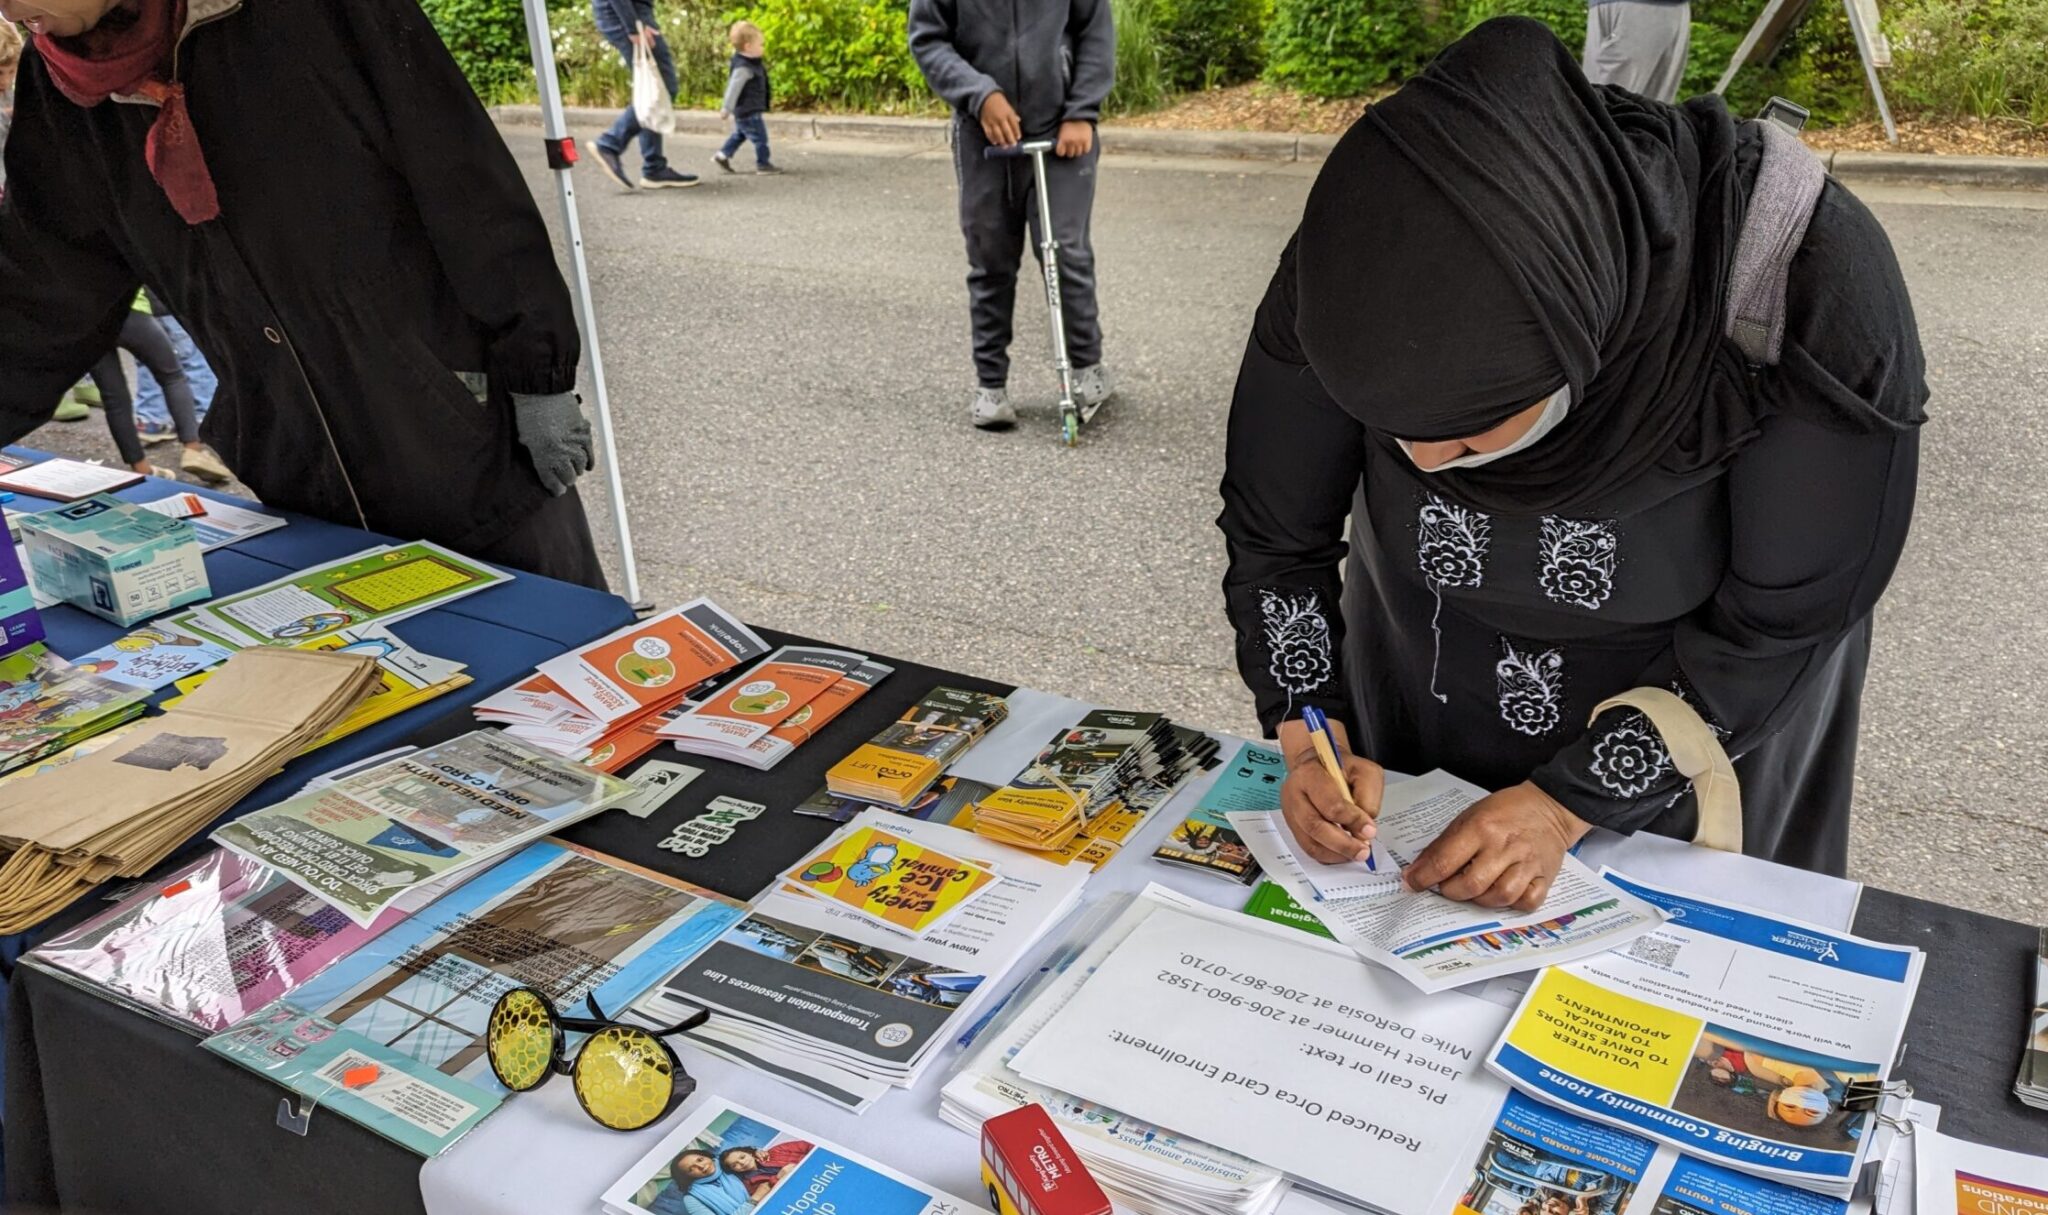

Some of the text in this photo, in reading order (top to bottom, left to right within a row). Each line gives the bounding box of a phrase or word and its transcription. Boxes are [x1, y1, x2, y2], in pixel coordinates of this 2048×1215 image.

[129, 592, 141, 602] 50
[706, 622, 749, 654] hopelink
[800, 656, 849, 668] hopelink
[581, 675, 627, 708] ASSISTANCE
[588, 690, 620, 711] TRAVEL
[718, 728, 750, 737] TRAVEL
[847, 759, 877, 771] LIFT
[1246, 749, 1281, 765] orca
[397, 761, 530, 820] NEED HELP WITH
[428, 760, 533, 807] ORCA CARD?
[1015, 798, 1064, 812] Community
[272, 825, 290, 833] A
[678, 826, 723, 841] KNOW YOUR
[687, 821, 730, 835] LOCATION?
[873, 820, 913, 834] hopelink
[284, 830, 329, 853] JOINING
[301, 827, 377, 866] QUICK SURVEY
[661, 838, 705, 854] 9-1-1
[677, 834, 695, 842] YOU
[318, 848, 342, 859] BY
[331, 854, 352, 864] IT
[254, 842, 346, 890] DO YOU NEED AN
[314, 858, 353, 878] CARD
[896, 858, 970, 882] Carnival
[341, 872, 384, 895] ORCA
[899, 872, 946, 893] Ice
[861, 883, 939, 914] Emery
[922, 933, 951, 946] your
[945, 941, 981, 955] Know
[1589, 967, 1612, 978] with
[1612, 975, 1630, 985] you
[1630, 982, 1662, 996] match
[1662, 992, 1674, 1000] to
[699, 967, 873, 1031] Transportation Resources Line
[1174, 951, 1473, 1060] Mike DeRosia at 206-867-0710.
[1637, 975, 1794, 1026] client in need of transportation!
[1674, 996, 1719, 1014] schedule
[1553, 993, 1671, 1040] APPOINTMENTS
[1720, 1009, 1744, 1021] your
[1155, 969, 1463, 1082] Janet Hammer at 206-960-1582
[1561, 1009, 1652, 1047] TO MEDICAL
[1745, 1017, 1782, 1033] around
[1784, 1028, 1809, 1040] work
[1533, 1008, 1670, 1065] TO DRIVE SENIORS
[1811, 1035, 1832, 1046] will
[1834, 1040, 1851, 1050] We
[1550, 1030, 1641, 1069] VOLUNTEER
[1297, 1042, 1448, 1104] Pls call or text:
[996, 1084, 1025, 1100] METRO
[1105, 1028, 1422, 1152] Reduced Orca Card Enrollment:
[1535, 1067, 1803, 1163] Bringing Community Home
[1501, 1118, 1537, 1137] YOUTH!
[1116, 1133, 1141, 1146] pass
[1142, 1142, 1183, 1161] annual
[1031, 1143, 1062, 1180] METRO
[1183, 1156, 1243, 1181] Subsidized
[1585, 1151, 1637, 1175] WELCOME
[781, 1161, 845, 1215] Hopelink
[1674, 1185, 1714, 1203] YOUTH!
[1963, 1183, 2048, 1212] nerations
